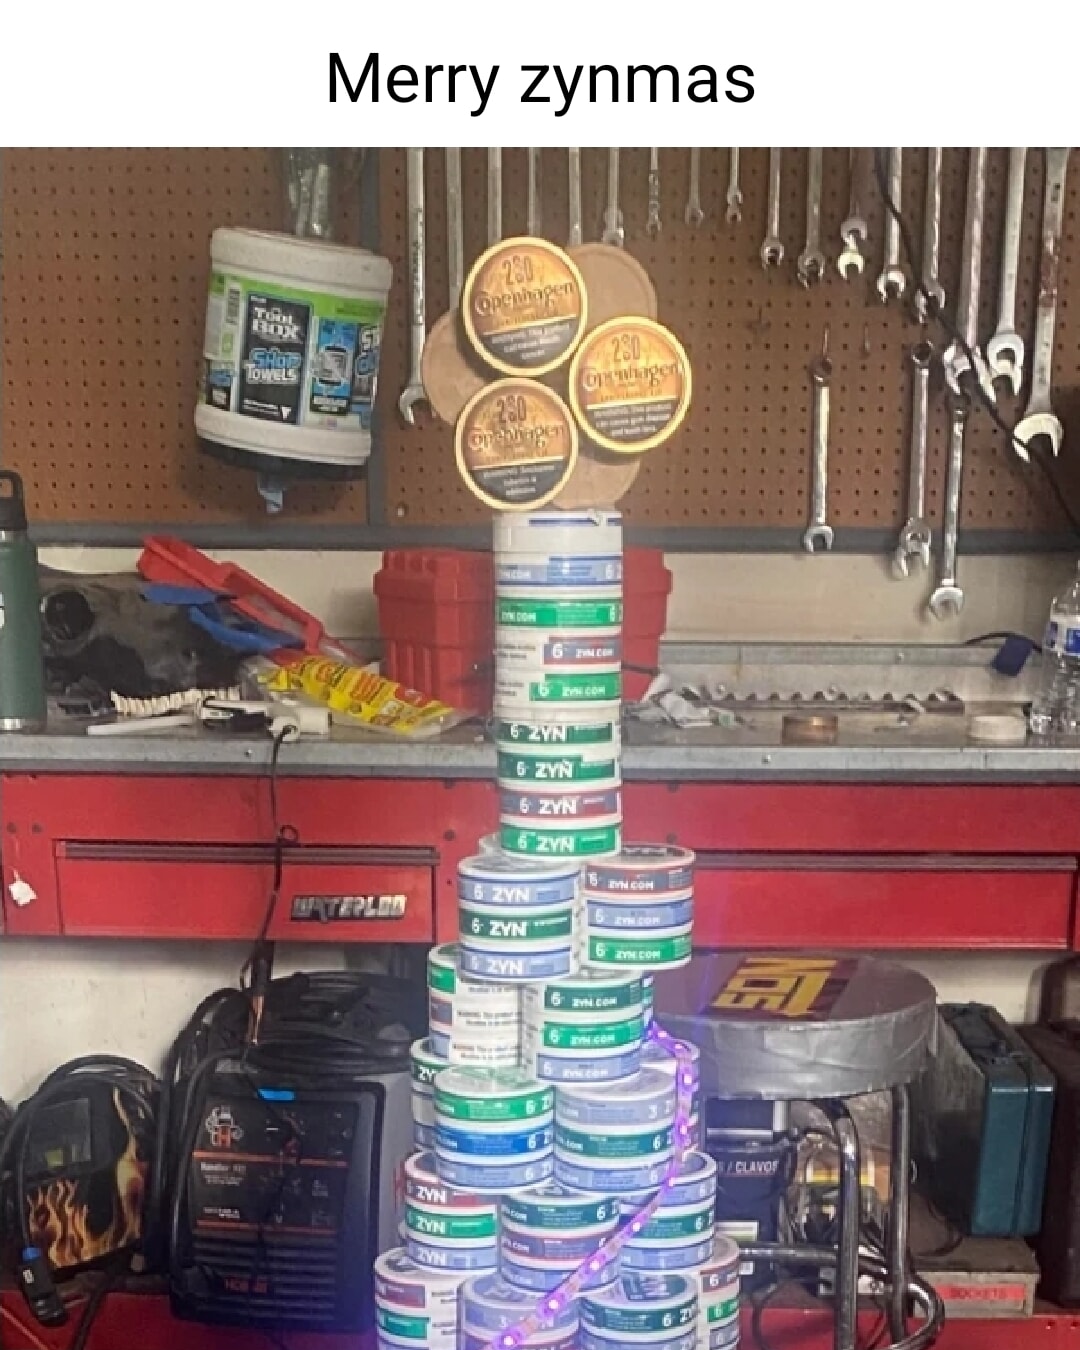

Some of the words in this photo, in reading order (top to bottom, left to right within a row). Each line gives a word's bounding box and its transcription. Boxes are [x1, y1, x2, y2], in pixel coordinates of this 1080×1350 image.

[529, 724, 566, 741] ZYN
[534, 760, 574, 778] ZYN
[537, 797, 577, 814] ZYN
[535, 836, 575, 852] ZYN
[491, 887, 531, 902] ZYN
[489, 921, 528, 937] ZYN
[487, 959, 524, 974] ZYN
[415, 1186, 447, 1203] ZYN
[416, 1215, 447, 1234] ZYN
